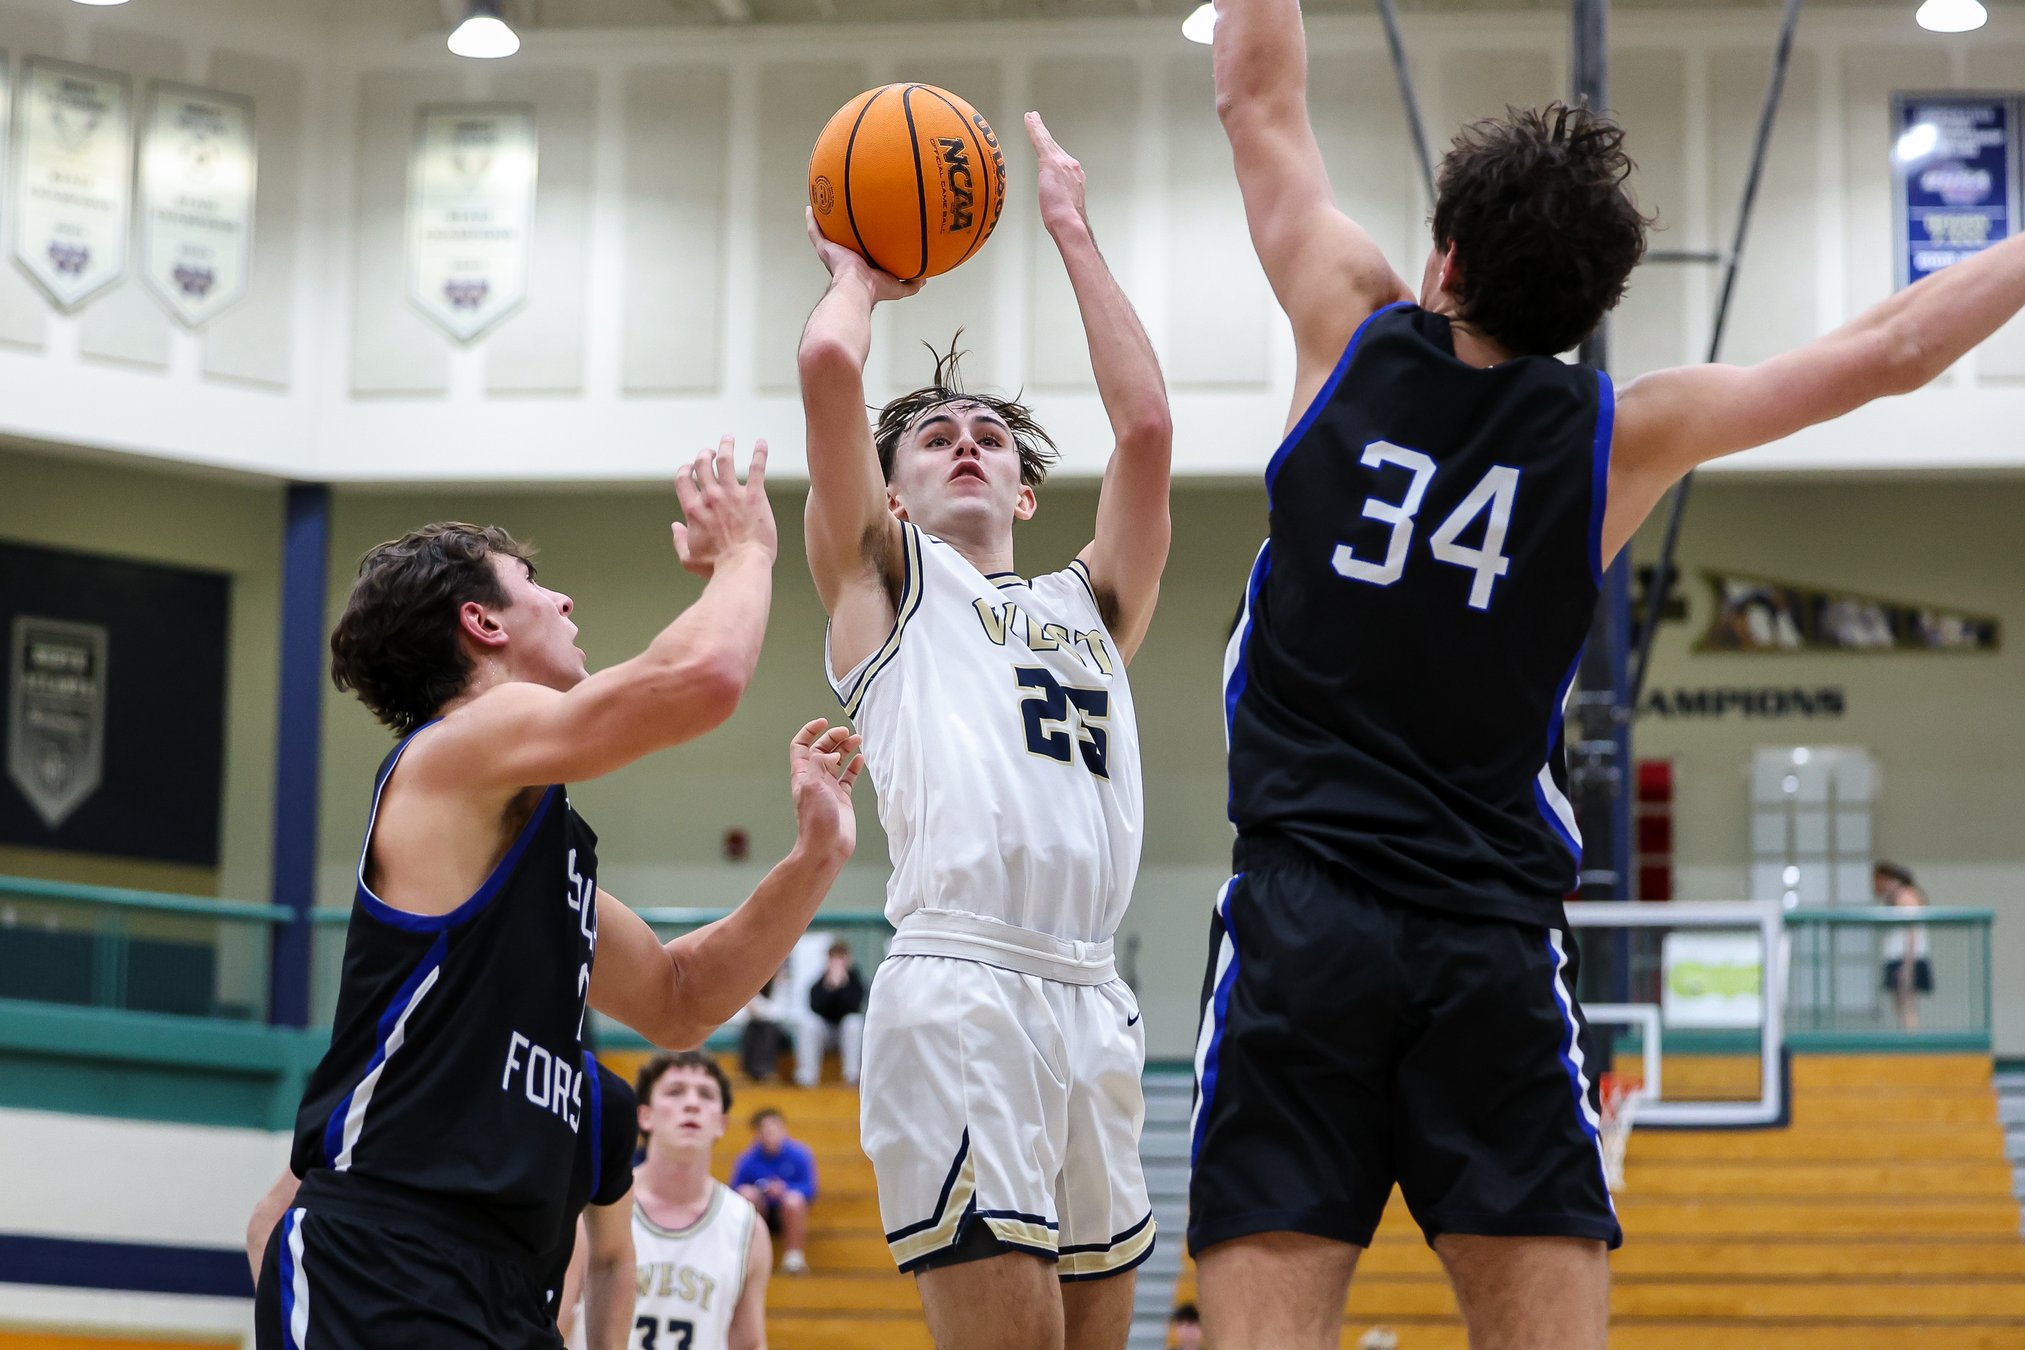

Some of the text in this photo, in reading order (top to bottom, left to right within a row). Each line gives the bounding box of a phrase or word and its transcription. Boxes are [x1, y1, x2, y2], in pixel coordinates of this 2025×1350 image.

[929, 137, 951, 235] OFFICIAL GAME BALL
[937, 136, 975, 234] NCAA
[1330, 437, 1523, 610] 34
[1010, 662, 1111, 784] 25
